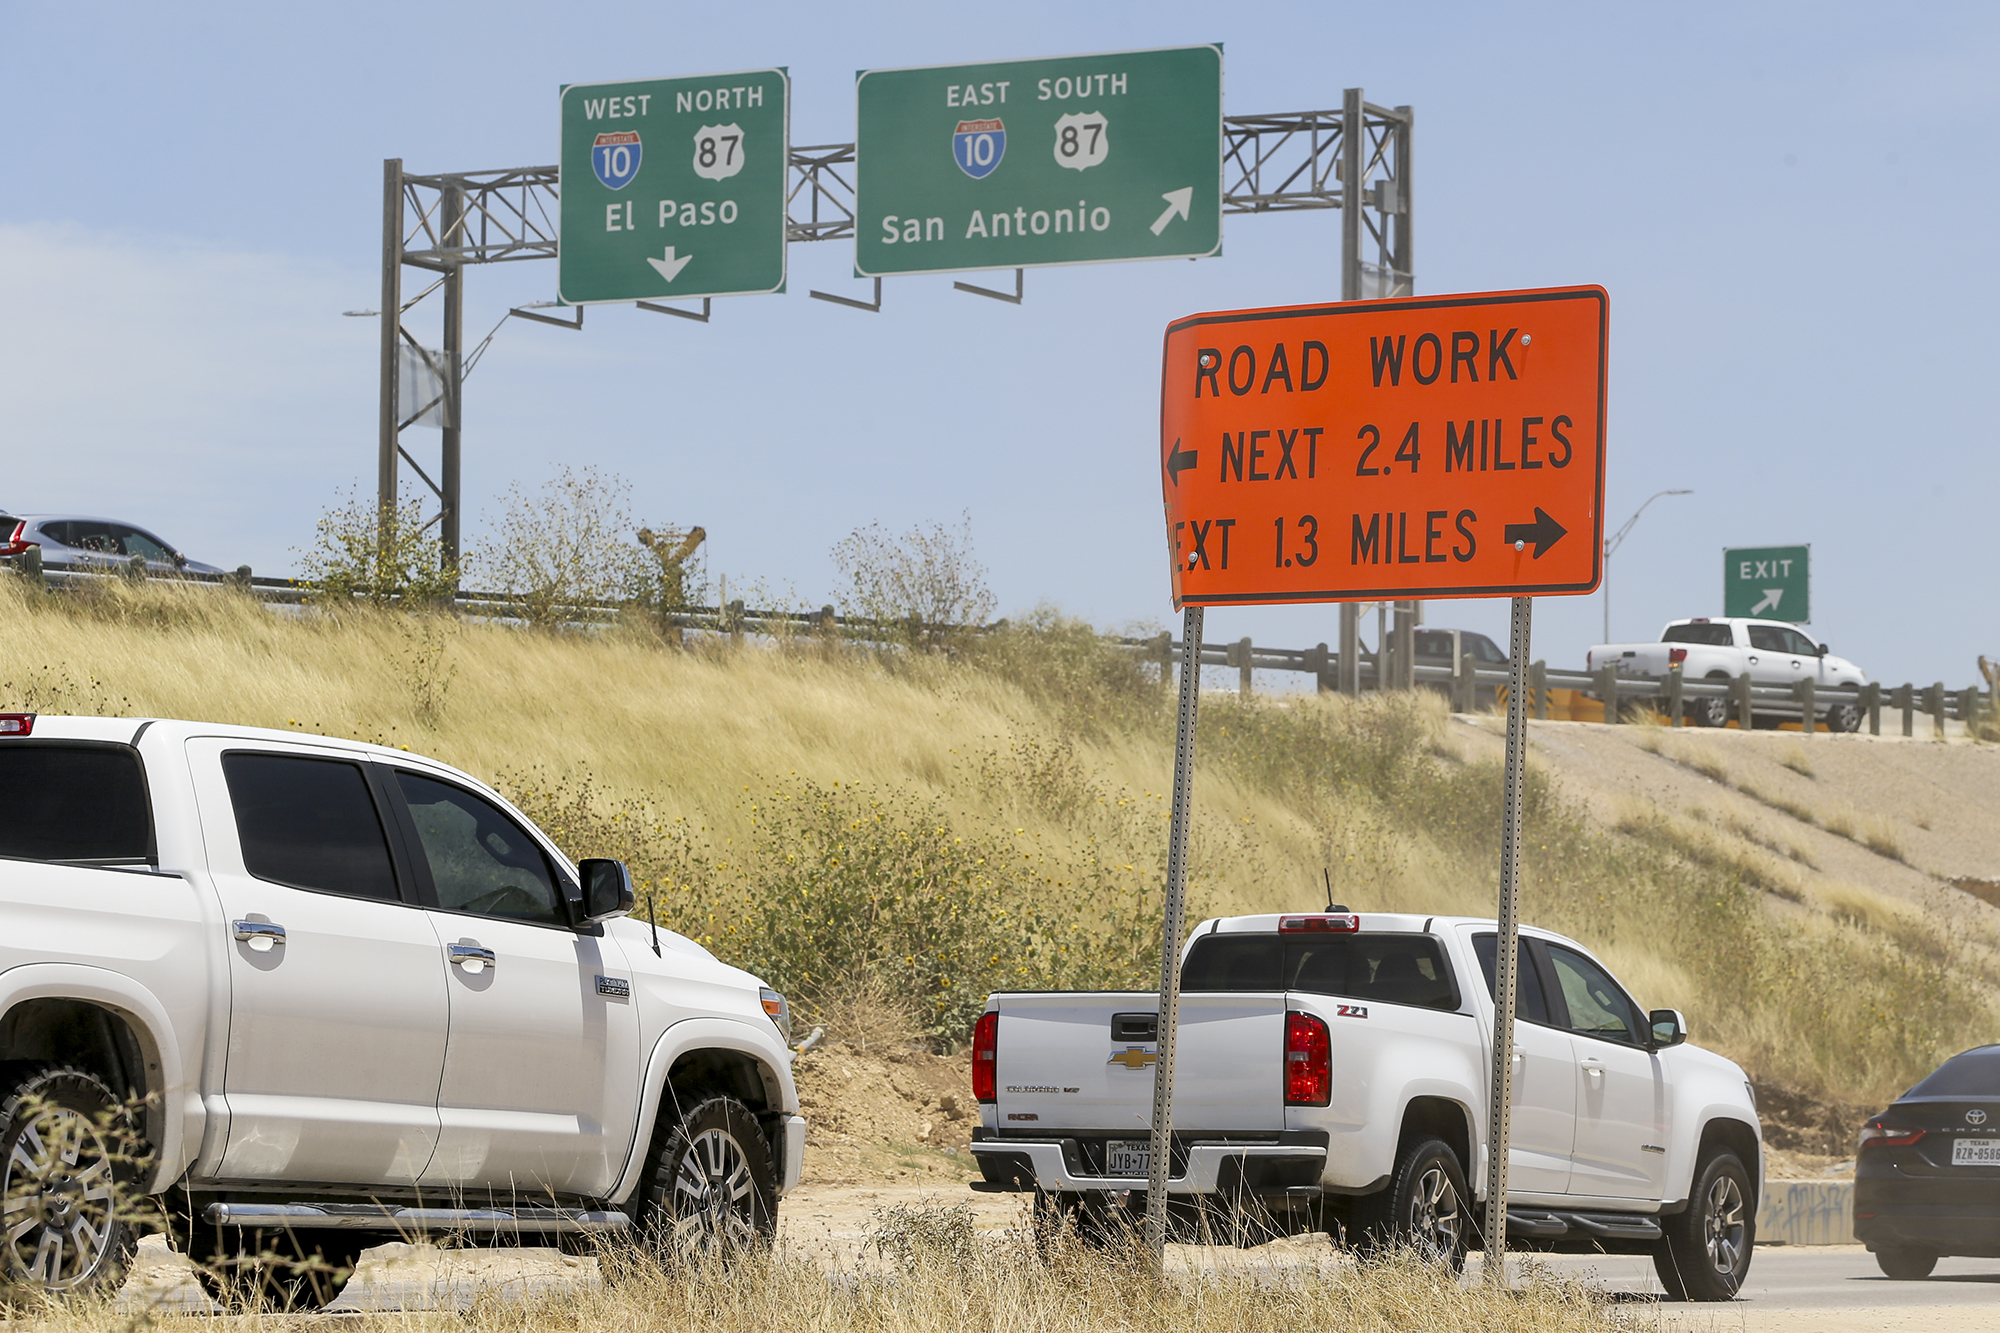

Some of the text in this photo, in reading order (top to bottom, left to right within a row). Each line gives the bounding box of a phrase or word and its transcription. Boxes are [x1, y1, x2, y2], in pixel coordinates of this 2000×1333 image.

[584, 85, 763, 120] WEST NORTH
[947, 73, 1127, 107] EAST SOUTH
[600, 135, 634, 145] INTERSTATE
[961, 121, 1000, 132] INTERSTATE
[602, 135, 739, 178] 10 87
[964, 123, 1102, 167] 10 87
[606, 199, 738, 232] El Paso
[881, 200, 1110, 244] San Antonio
[1195, 328, 1519, 399] ROAD WORK
[1220, 414, 1573, 483] NEXT 2.4 MILES
[1274, 514, 1318, 568] 1.3
[1350, 508, 1478, 566] MILES
[1740, 559, 1793, 579] EXIT
[1337, 1004, 1368, 1019] Z71
